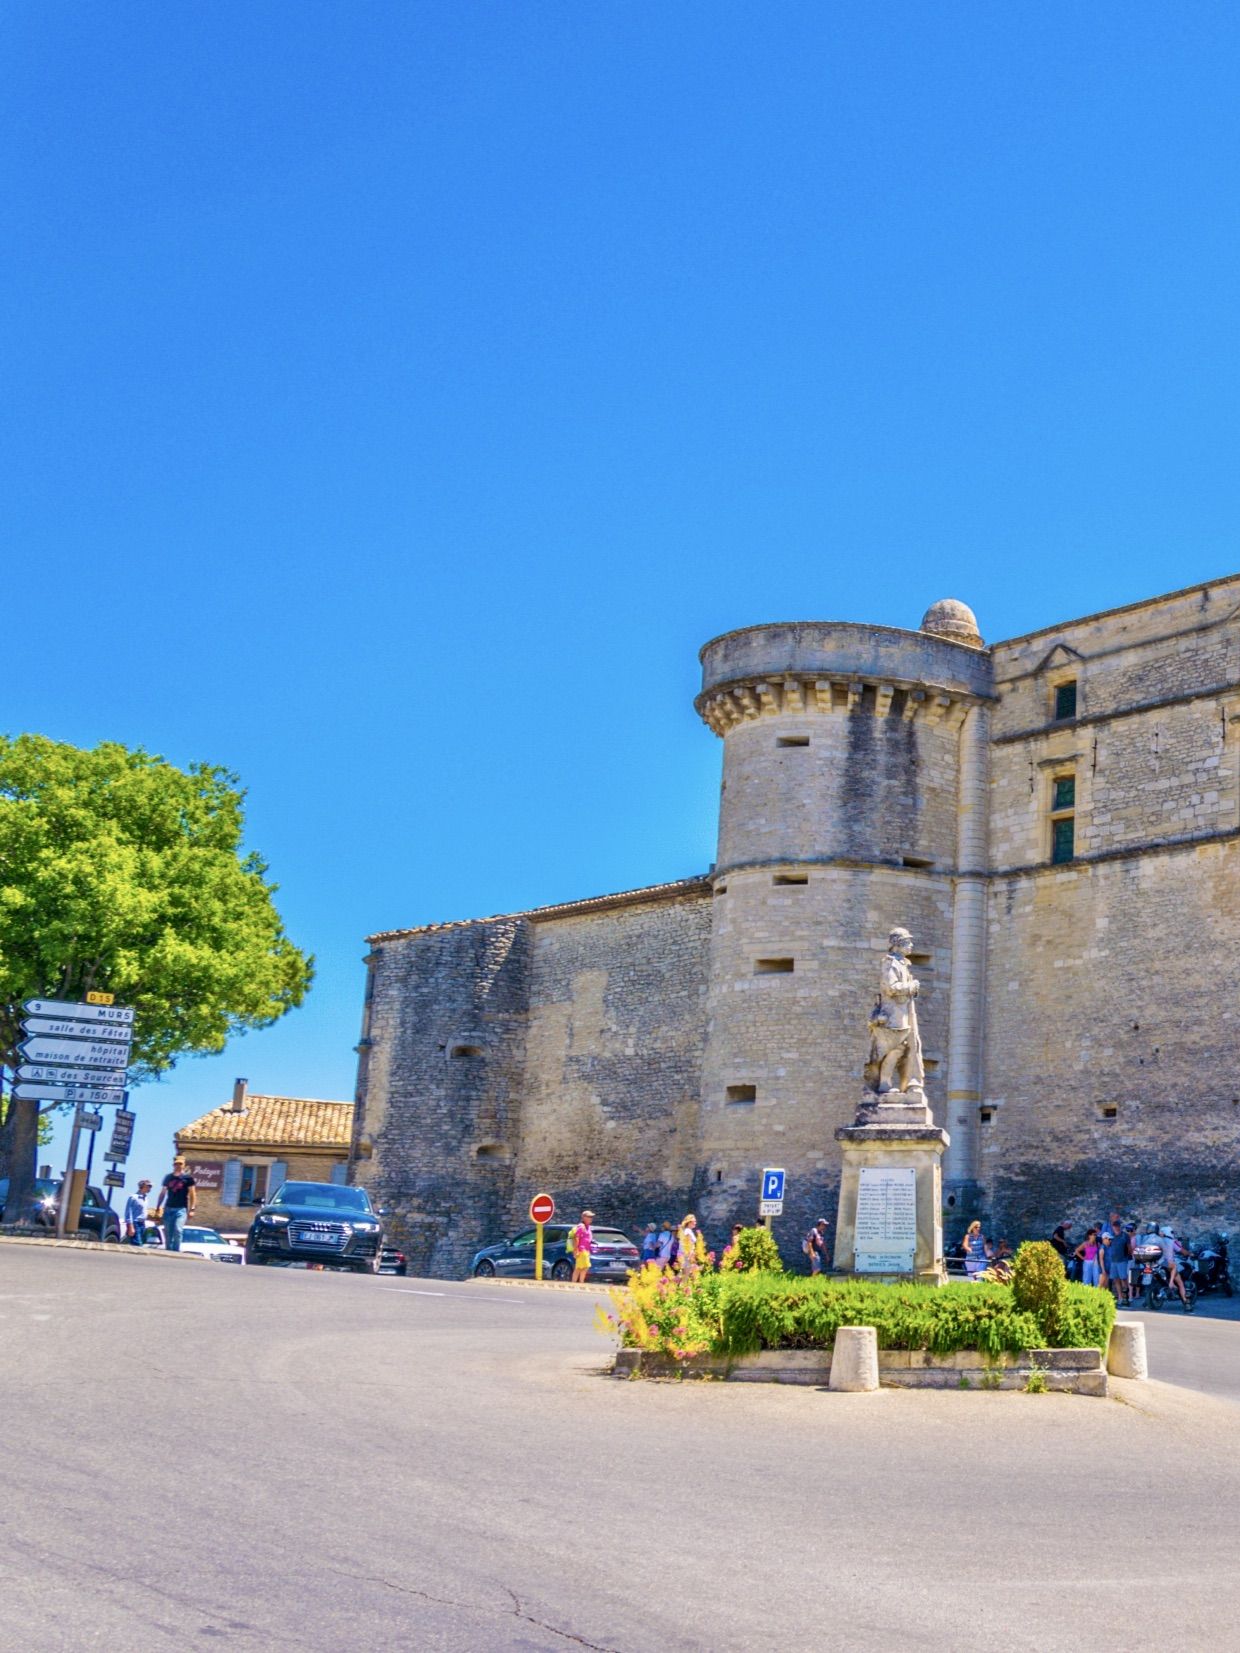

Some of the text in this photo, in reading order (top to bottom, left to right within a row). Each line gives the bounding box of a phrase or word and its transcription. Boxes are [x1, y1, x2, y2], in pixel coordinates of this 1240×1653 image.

[90, 993, 111, 1003] D 15
[35, 1003, 41, 1011] 9
[98, 1010, 130, 1020] MURS
[49, 1024, 129, 1038] salle des Fêtes
[90, 1045, 128, 1056] hôpital
[34, 1052, 125, 1065] maison de retraite
[60, 1071, 78, 1080] des
[90, 1091, 109, 1100] 150
[768, 1176, 778, 1194] P
